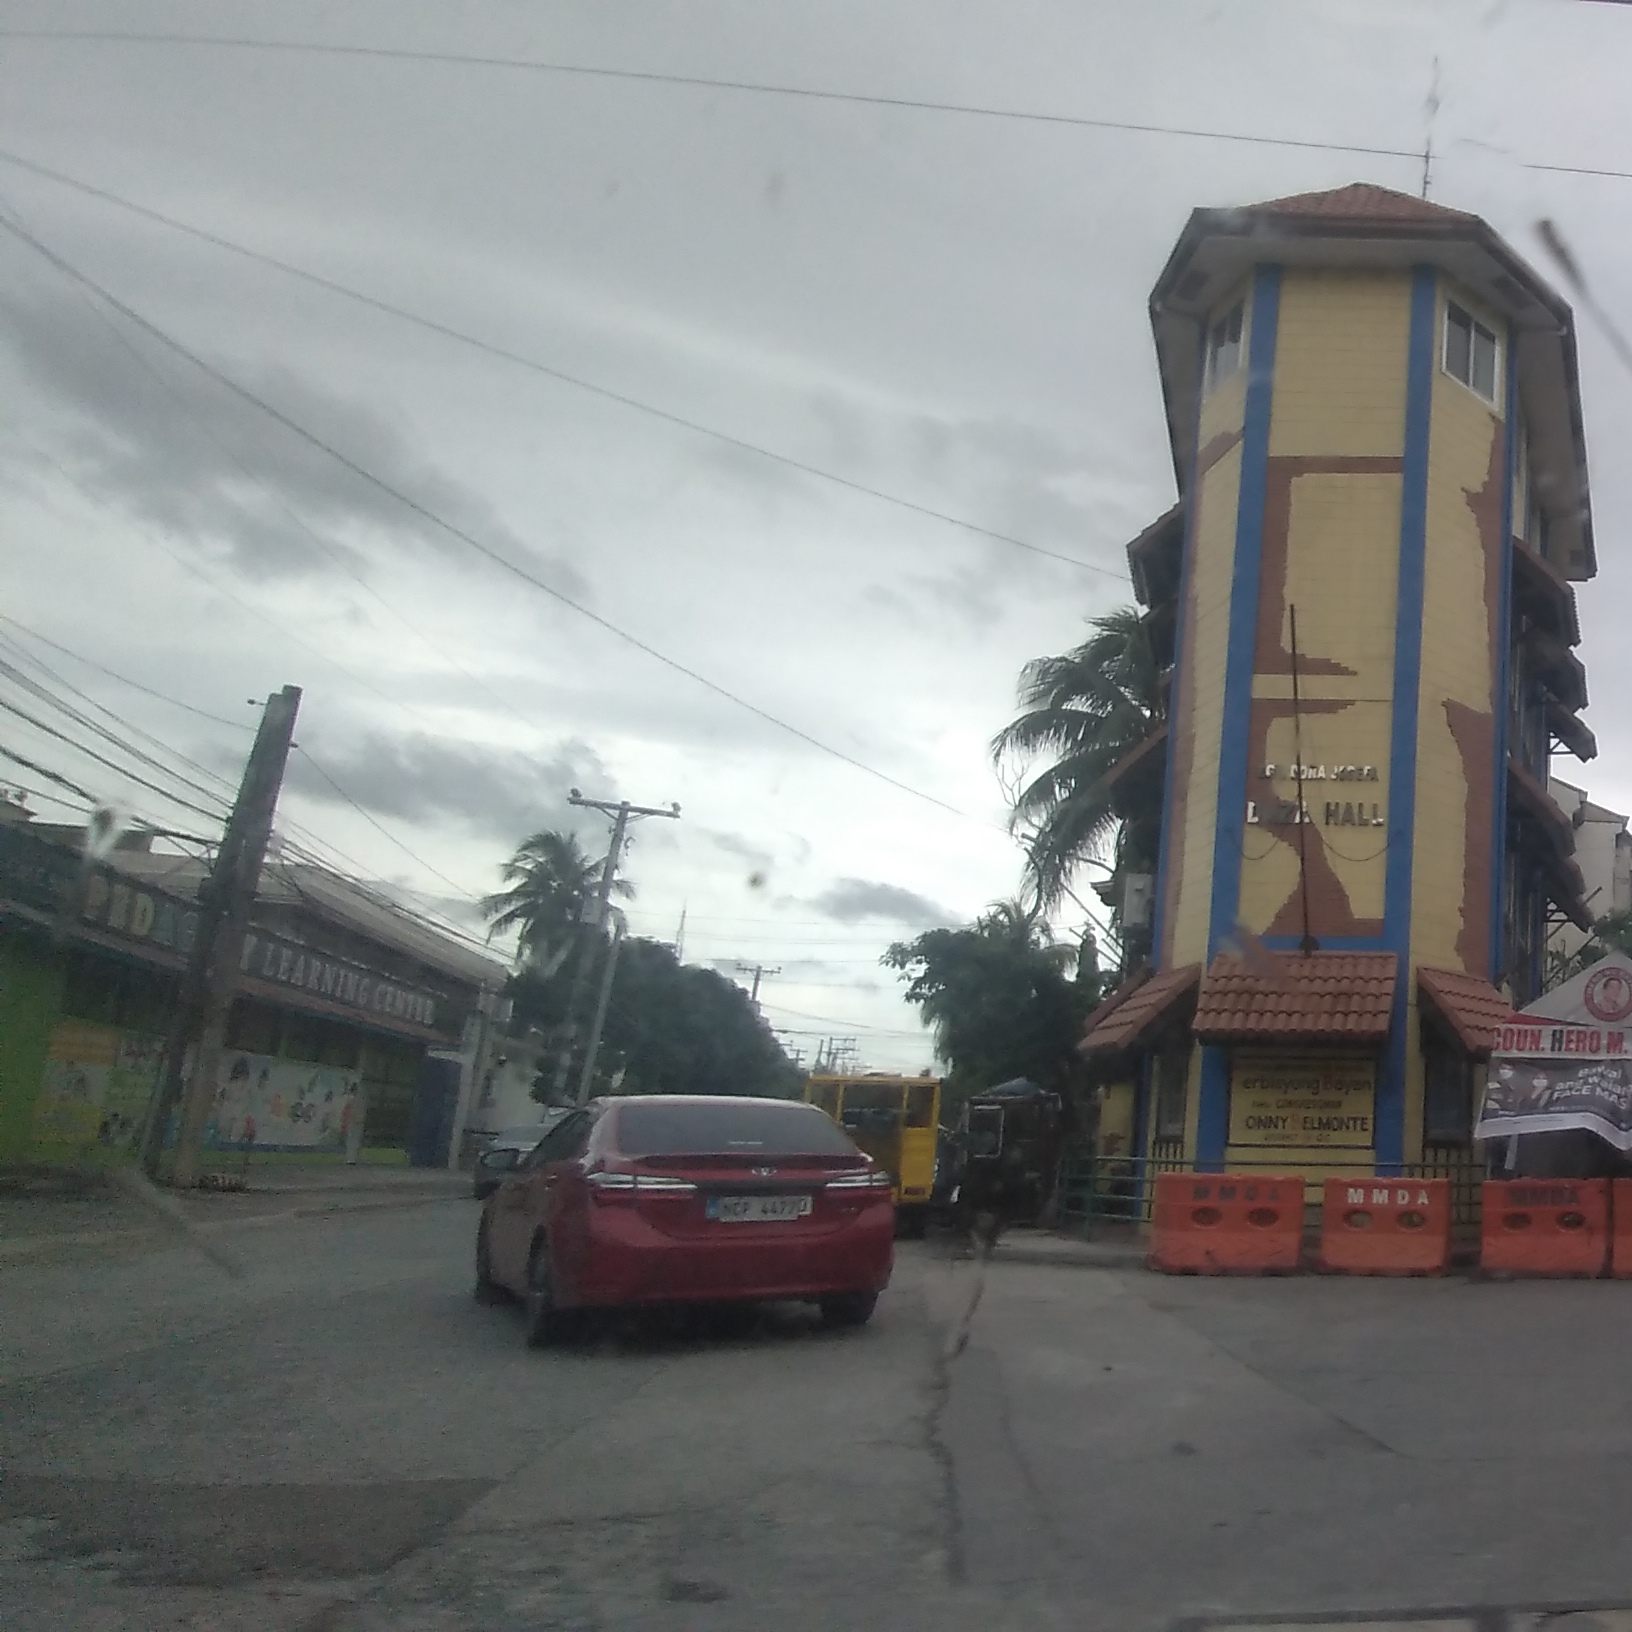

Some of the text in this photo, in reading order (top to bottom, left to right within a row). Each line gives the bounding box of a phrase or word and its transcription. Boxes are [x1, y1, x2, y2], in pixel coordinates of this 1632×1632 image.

[1325, 801, 1385, 826] HALL
[262, 942, 370, 1005] LEARNING
[1550, 1028, 1600, 1053] HERO
[1552, 1084, 1630, 1111] FACE MAS
[1292, 1114, 1370, 1133] ELMONTE
[1347, 1187, 1430, 1205] MMDA
